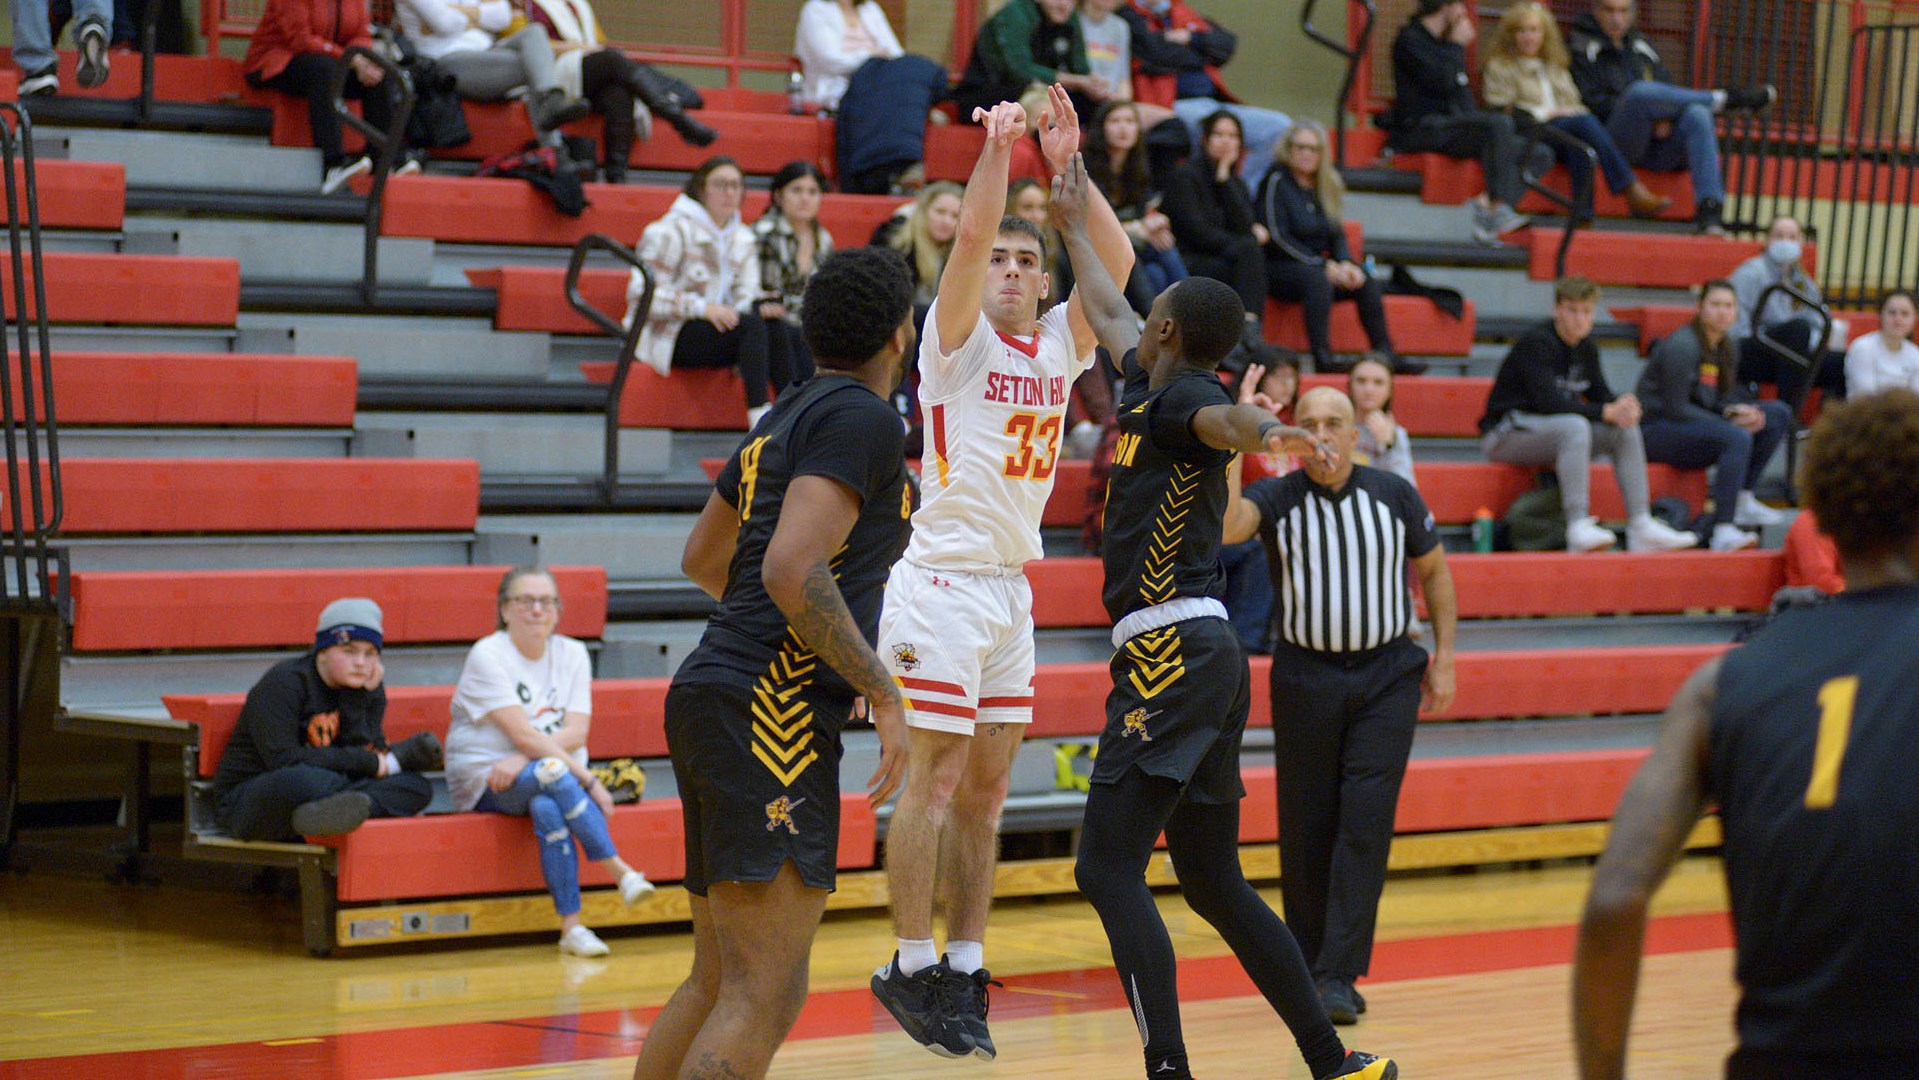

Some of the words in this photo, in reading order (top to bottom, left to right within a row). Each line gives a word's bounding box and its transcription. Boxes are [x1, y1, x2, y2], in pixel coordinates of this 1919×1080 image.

[984, 371, 1045, 406] SETON
[1003, 412, 1061, 480] 33
[1803, 674, 1860, 810] 1
